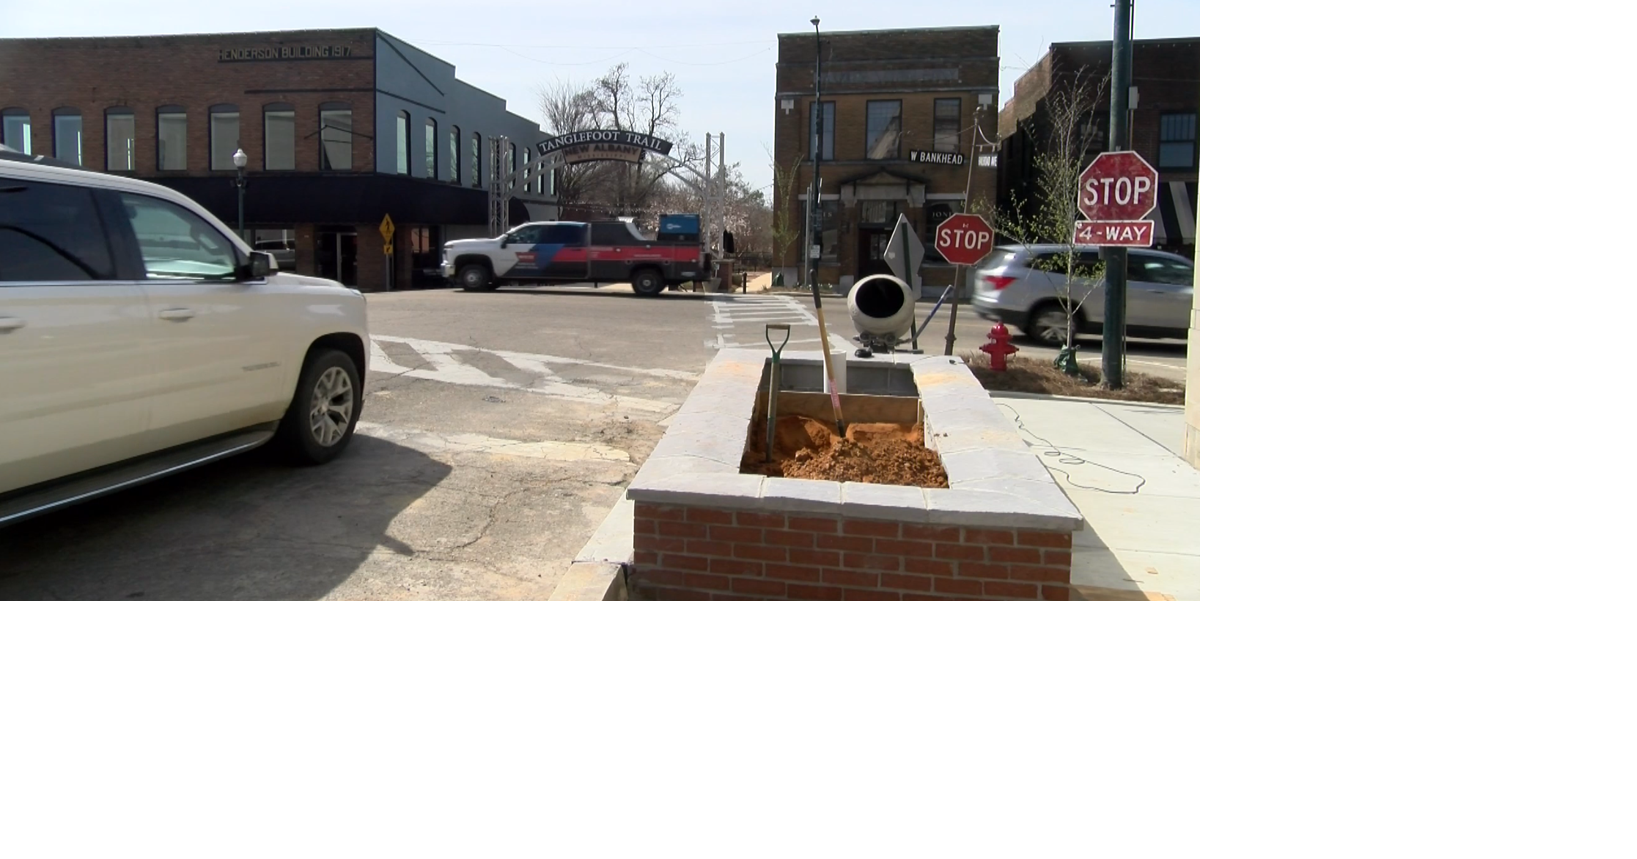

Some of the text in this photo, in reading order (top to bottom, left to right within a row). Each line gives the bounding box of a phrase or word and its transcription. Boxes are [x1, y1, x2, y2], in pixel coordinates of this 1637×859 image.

[218, 45, 352, 61] HENDERSON BUILDING 1917
[539, 131, 662, 153] TANGLEFOOT TRAIL
[565, 143, 639, 156] NEW ALBANY
[910, 150, 963, 165] W BANKHEAD
[1083, 176, 1151, 206] STOP
[940, 228, 990, 250] STOP
[1079, 226, 1147, 241] 4-WAY
